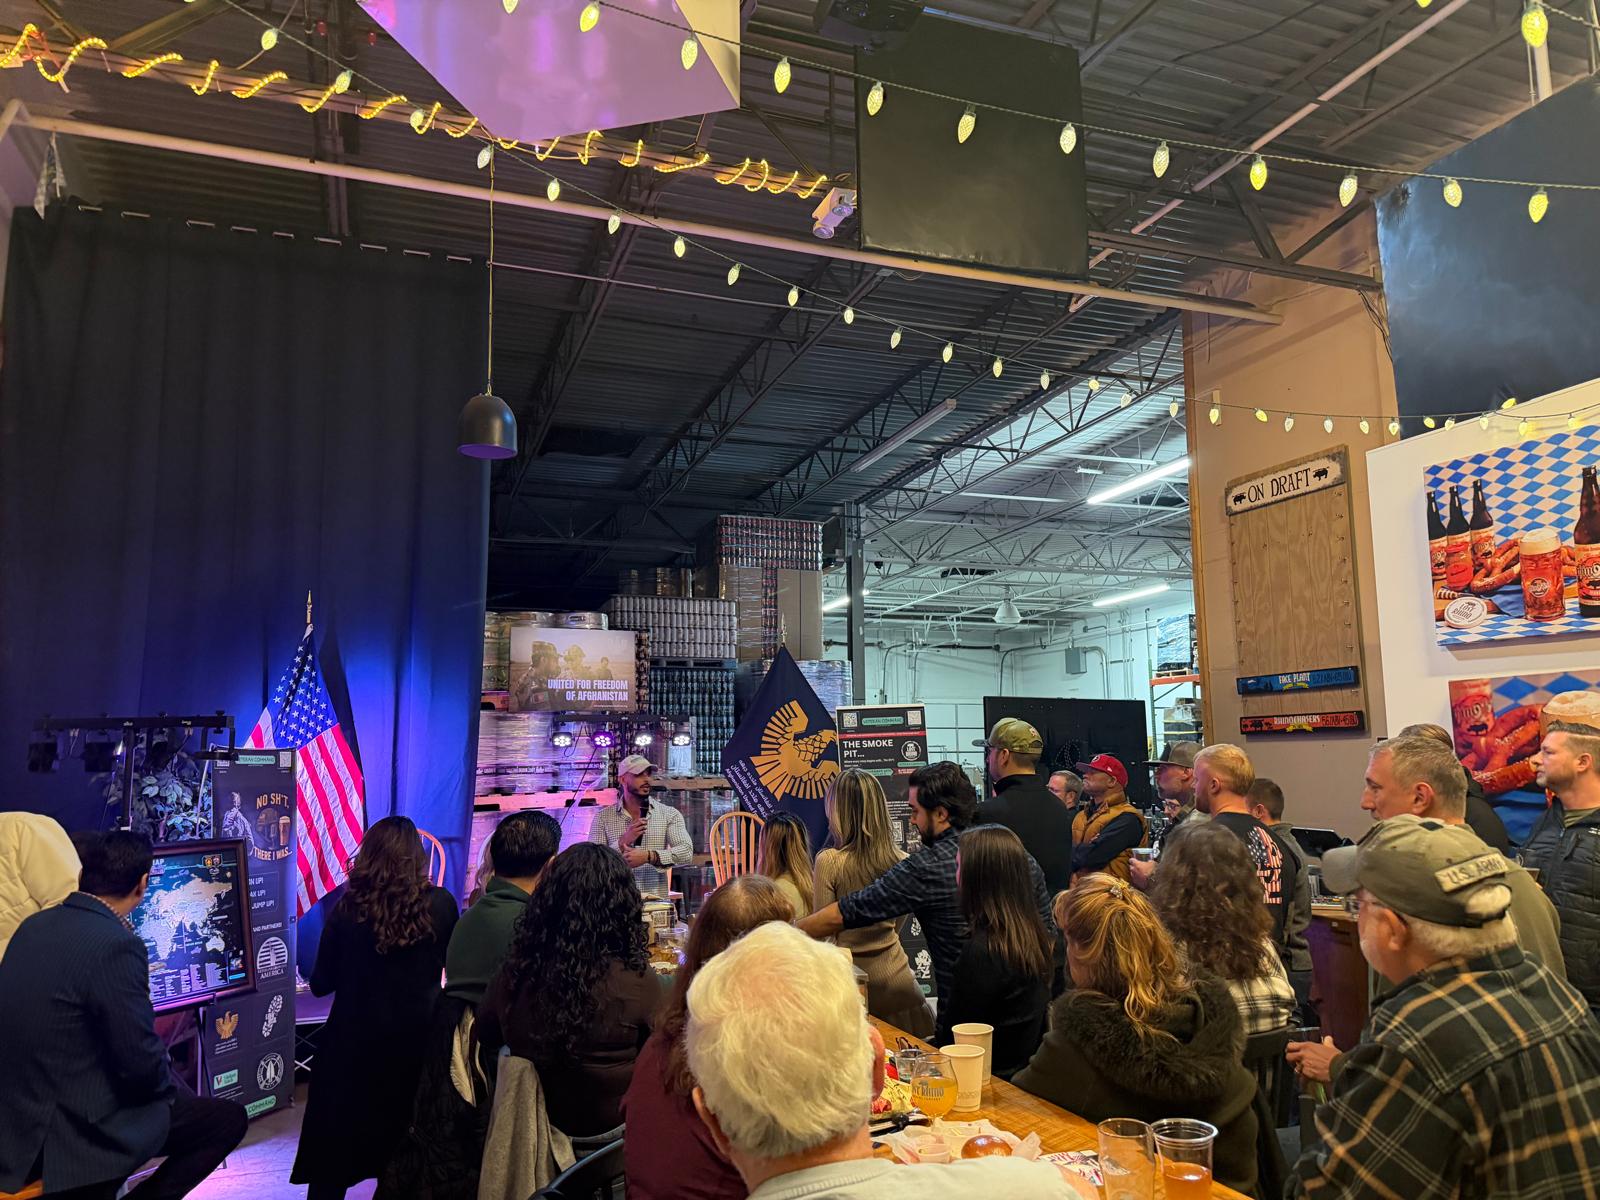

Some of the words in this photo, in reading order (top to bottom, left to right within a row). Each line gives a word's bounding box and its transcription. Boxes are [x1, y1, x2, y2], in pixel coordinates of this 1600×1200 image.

[1247, 484, 1264, 503] ON
[1270, 468, 1311, 498] DRAFT
[1293, 672, 1311, 683] PLANT
[547, 679, 575, 690] UNITED
[577, 679, 592, 690] FOR
[593, 679, 629, 690] FREEDOM
[565, 690, 576, 701] OF
[577, 690, 629, 701] AFGHANISTAN
[1274, 714, 1321, 725] RHINOCHASERS
[843, 741, 861, 749] THE
[862, 739, 894, 748] SMOKE
[256, 794, 268, 810] NO
[254, 846, 272, 860] THERE
[272, 851, 276, 860] I
[260, 968, 285, 980] AMERICA
